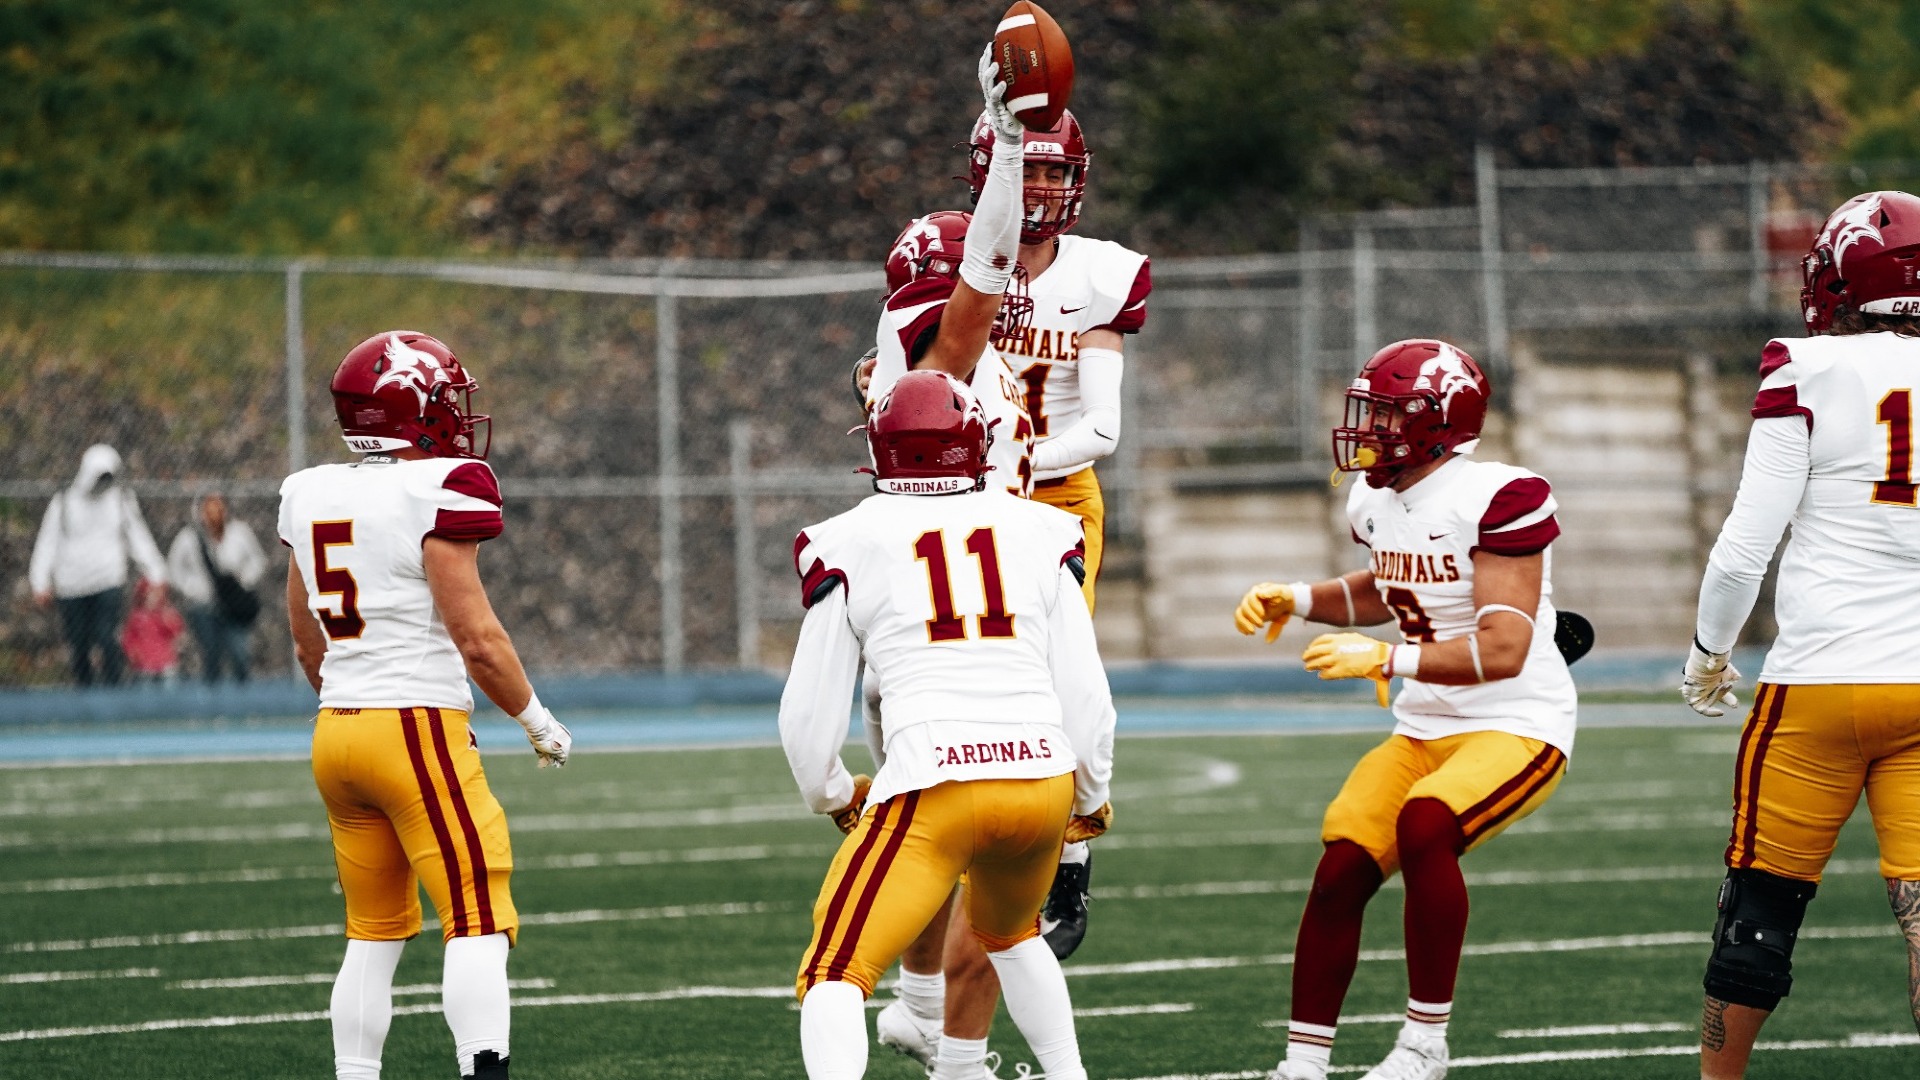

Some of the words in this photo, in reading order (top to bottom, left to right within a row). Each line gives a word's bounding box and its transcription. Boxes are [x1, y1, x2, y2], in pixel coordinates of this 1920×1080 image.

[1003, 42, 1015, 86] Wilson
[1030, 50, 1038, 67] NCAA
[1892, 301, 1920, 314] CAR
[1870, 388, 1920, 507] 1
[890, 480, 958, 493] CARDINALS
[312, 519, 365, 641] 5
[912, 525, 1017, 644] 11
